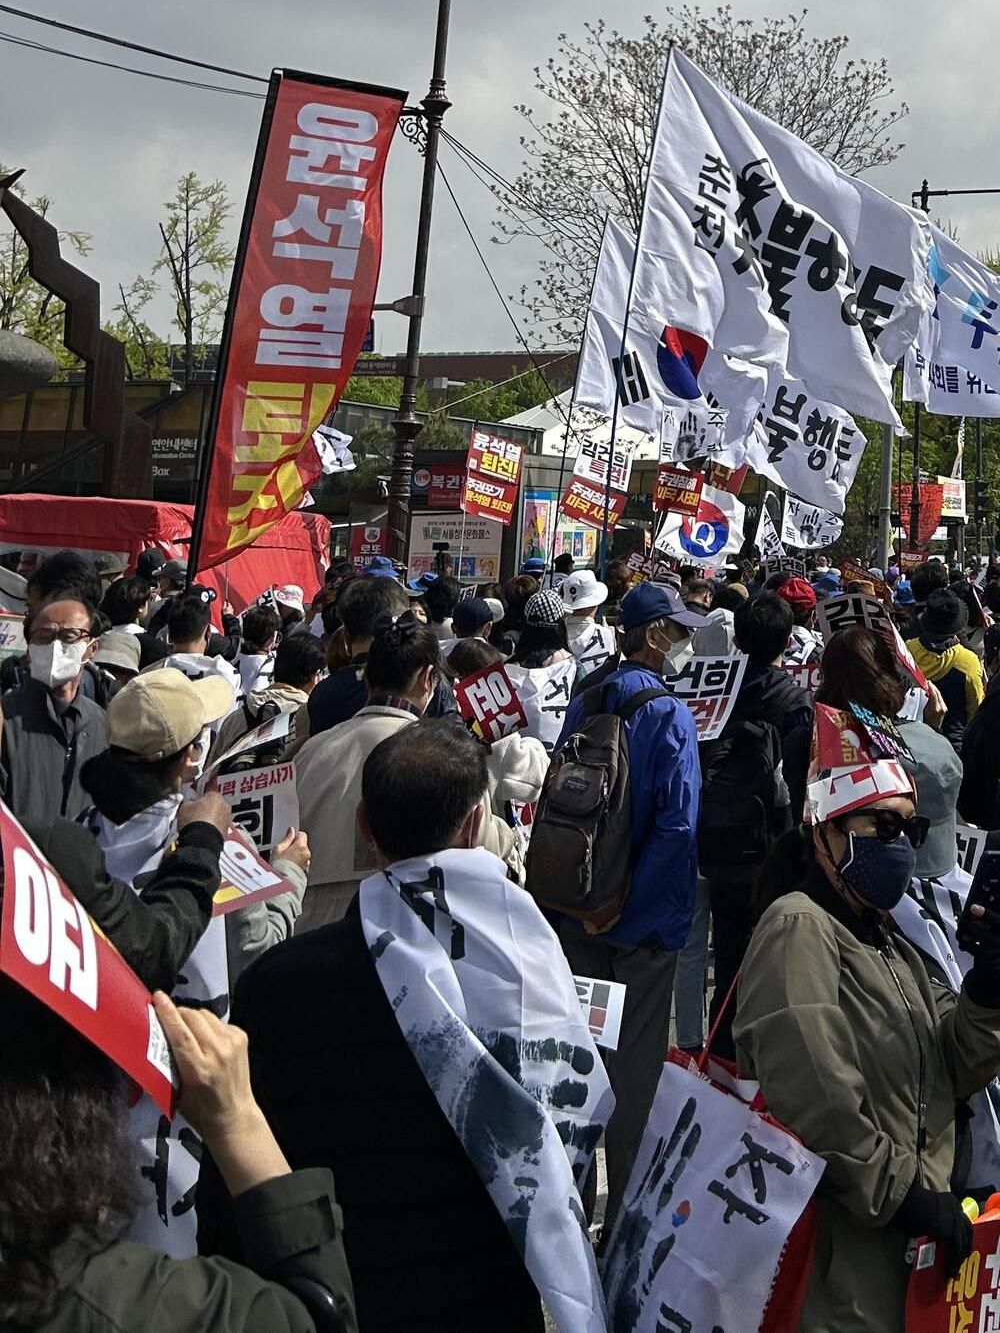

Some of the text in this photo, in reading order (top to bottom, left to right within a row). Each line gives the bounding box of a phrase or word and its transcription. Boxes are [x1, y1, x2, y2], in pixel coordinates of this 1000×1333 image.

[227, 102, 379, 551] 윤석열 퇴진
[472, 431, 523, 461] 윤석열
[581, 437, 628, 469] 김건희
[479, 452, 518, 480] 퇴진!
[589, 458, 628, 487] 특검!
[431, 474, 467, 489] 복권
[466, 476, 505, 499] 주권포기
[657, 486, 676, 502] 미국
[658, 470, 698, 491] 주권침해
[465, 490, 491, 509] 윤석열
[566, 495, 591, 515] 미국
[360, 544, 382, 555] 로또
[665, 659, 741, 699] 건희
[687, 697, 730, 733] 검!
[240, 763, 294, 795] 상습사기
